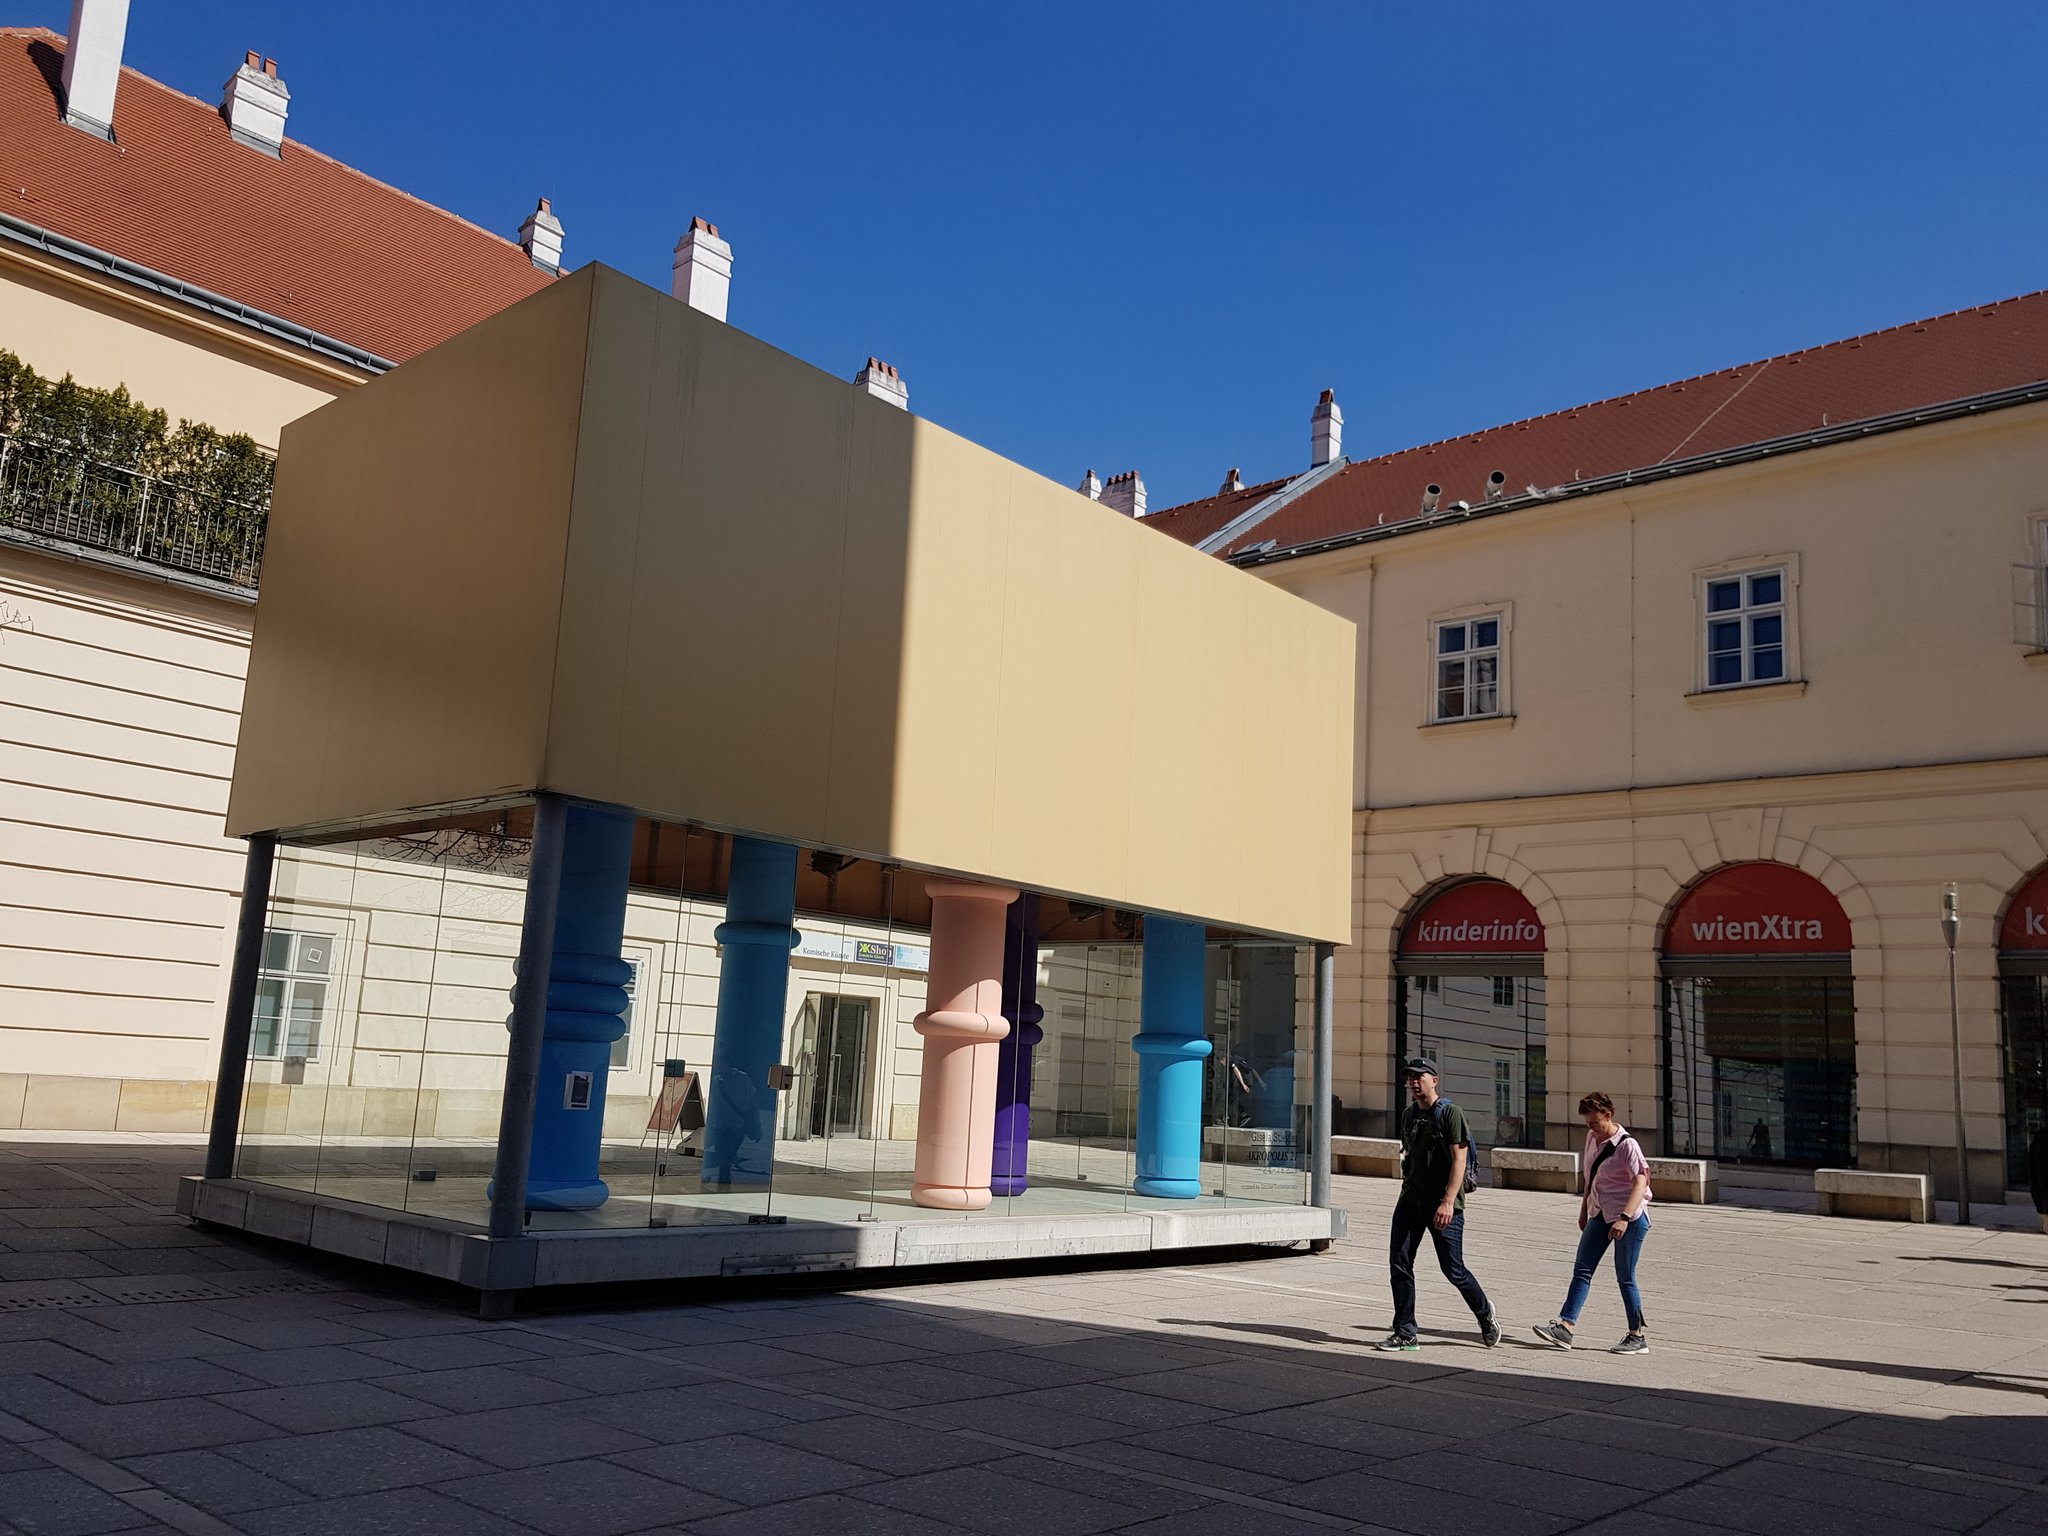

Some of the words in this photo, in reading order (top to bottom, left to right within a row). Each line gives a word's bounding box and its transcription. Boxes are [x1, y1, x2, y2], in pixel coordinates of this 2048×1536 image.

[1417, 918, 1539, 942] kinderinfo
[1691, 914, 1823, 941] wienXtra
[802, 947, 830, 958] Komische
[1251, 1131, 1272, 1142] Gisela
[1246, 1150, 1289, 1161] AKROPOLIS
